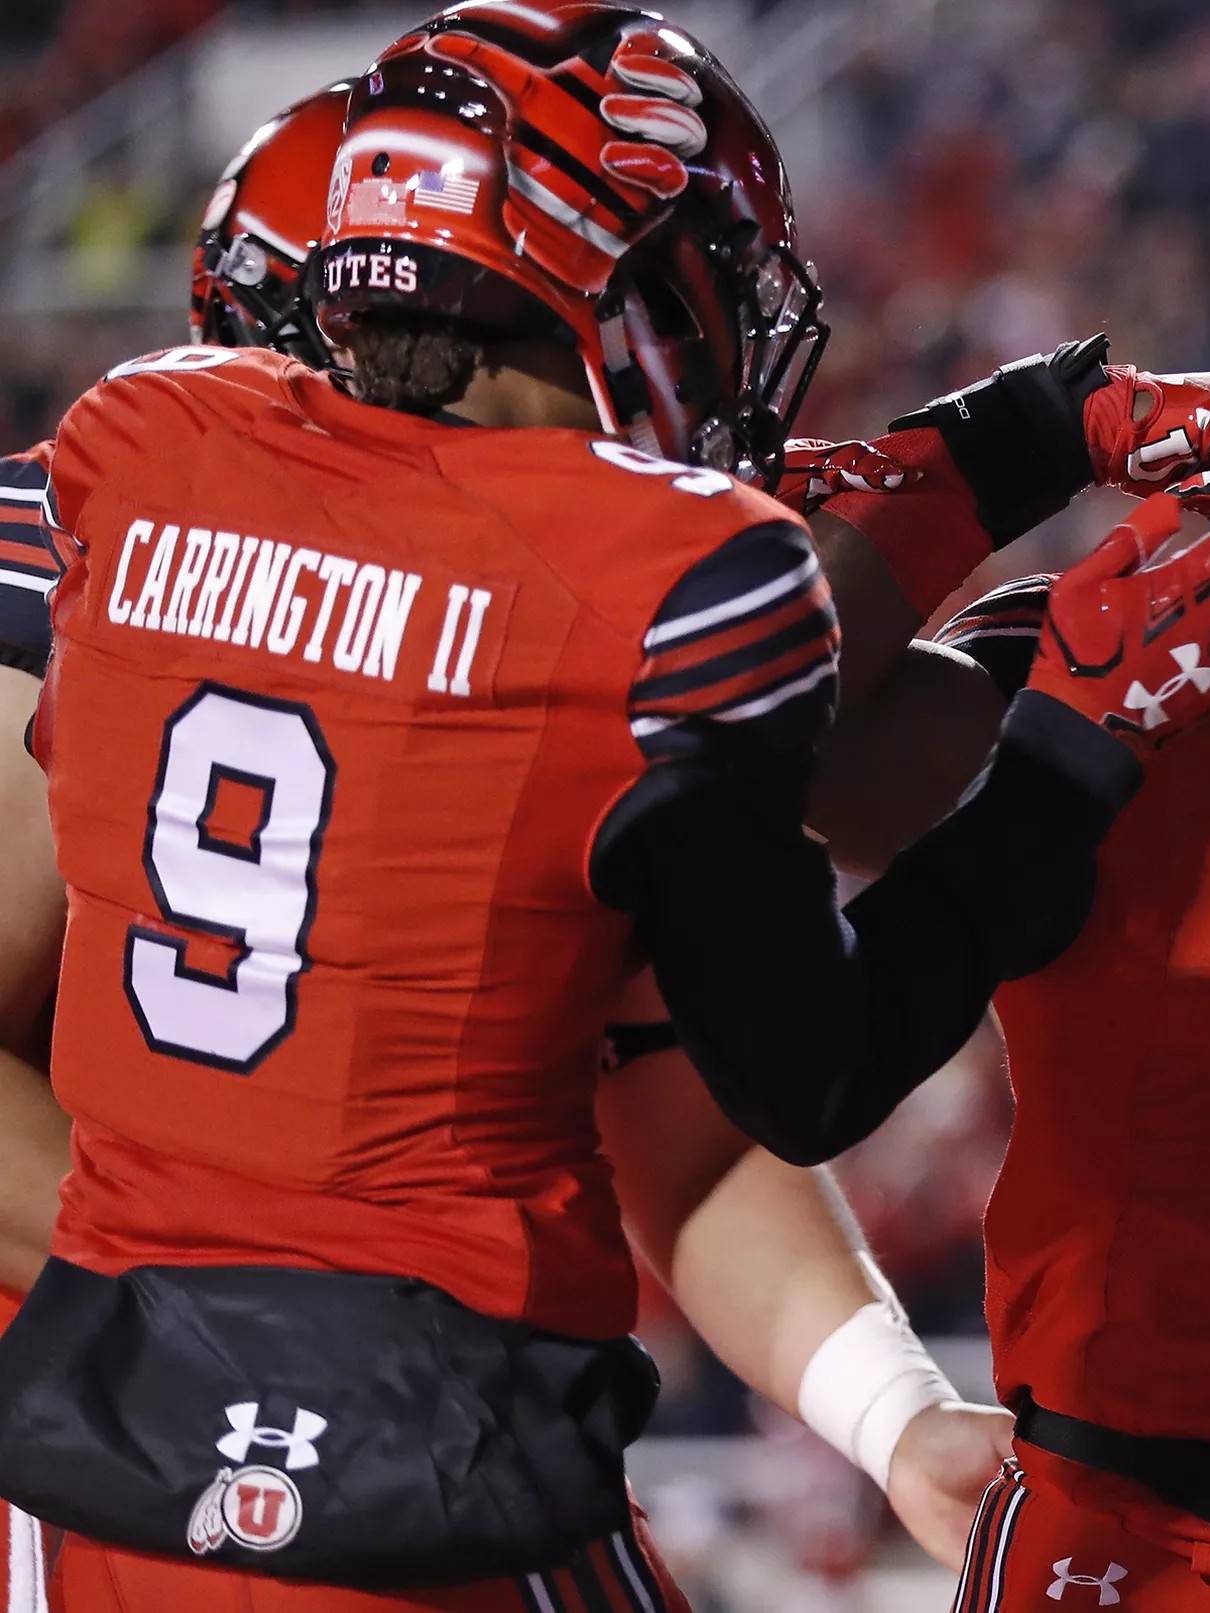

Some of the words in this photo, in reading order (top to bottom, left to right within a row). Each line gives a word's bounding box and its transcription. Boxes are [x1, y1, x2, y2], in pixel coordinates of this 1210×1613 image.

[327, 254, 418, 293] UTES
[107, 518, 422, 682] CARRINGTON
[427, 583, 493, 697] II
[123, 679, 338, 1076] 9
[236, 1482, 287, 1539] U
